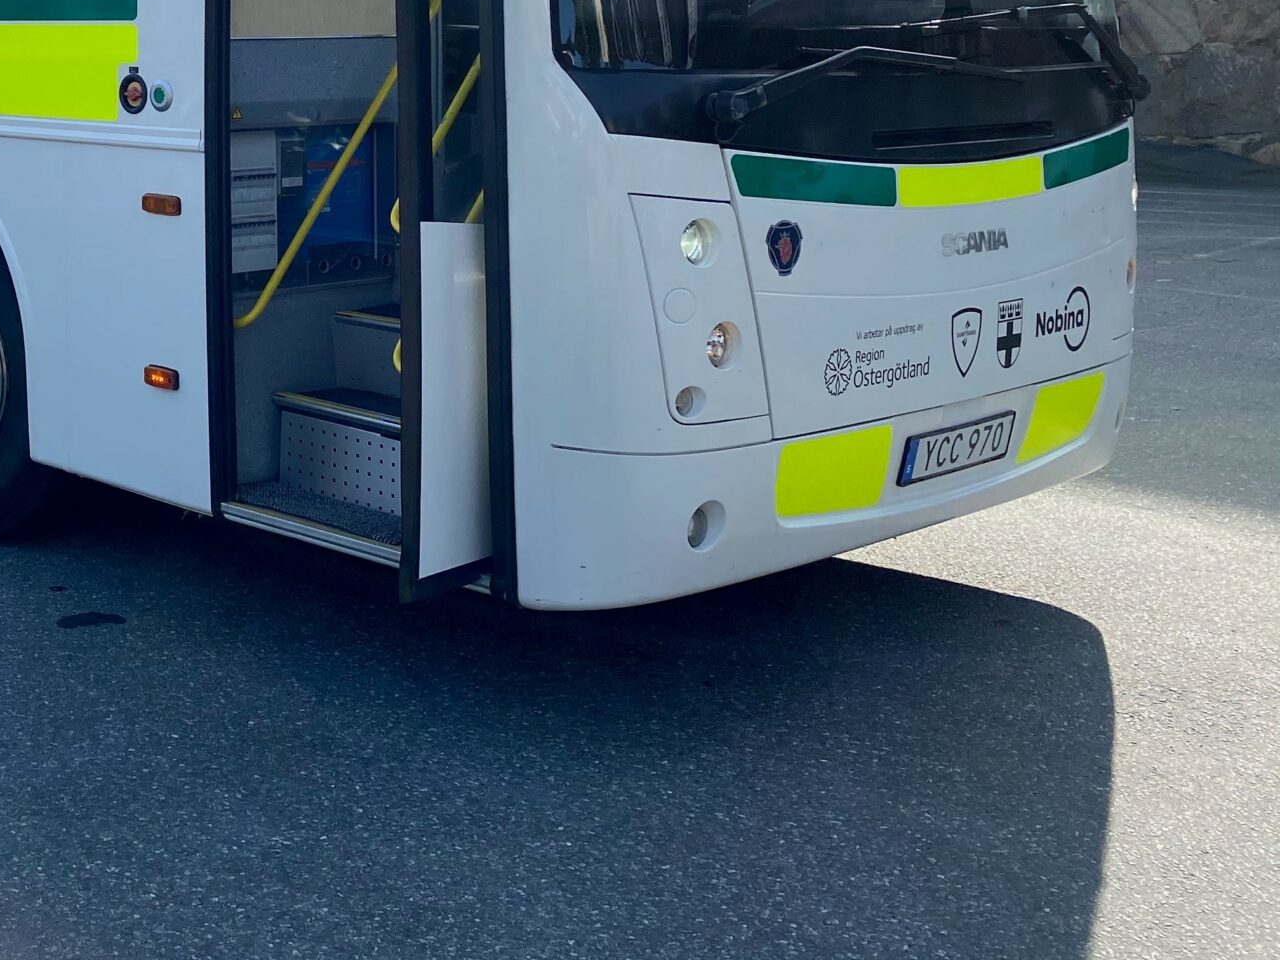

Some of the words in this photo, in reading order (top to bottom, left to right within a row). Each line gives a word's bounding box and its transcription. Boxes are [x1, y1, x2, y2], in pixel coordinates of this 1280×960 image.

[941, 227, 1009, 257] SCANIA
[856, 330, 862, 341] Vi
[863, 328, 884, 340] arbetar
[885, 325, 892, 338] på
[893, 323, 916, 335] uppdrag
[917, 322, 924, 331] av
[1035, 304, 1084, 338] Nobina
[853, 355, 931, 388] Östergötland
[855, 348, 885, 366] Region
[924, 432, 964, 472] YCC
[967, 422, 1004, 460] 970
